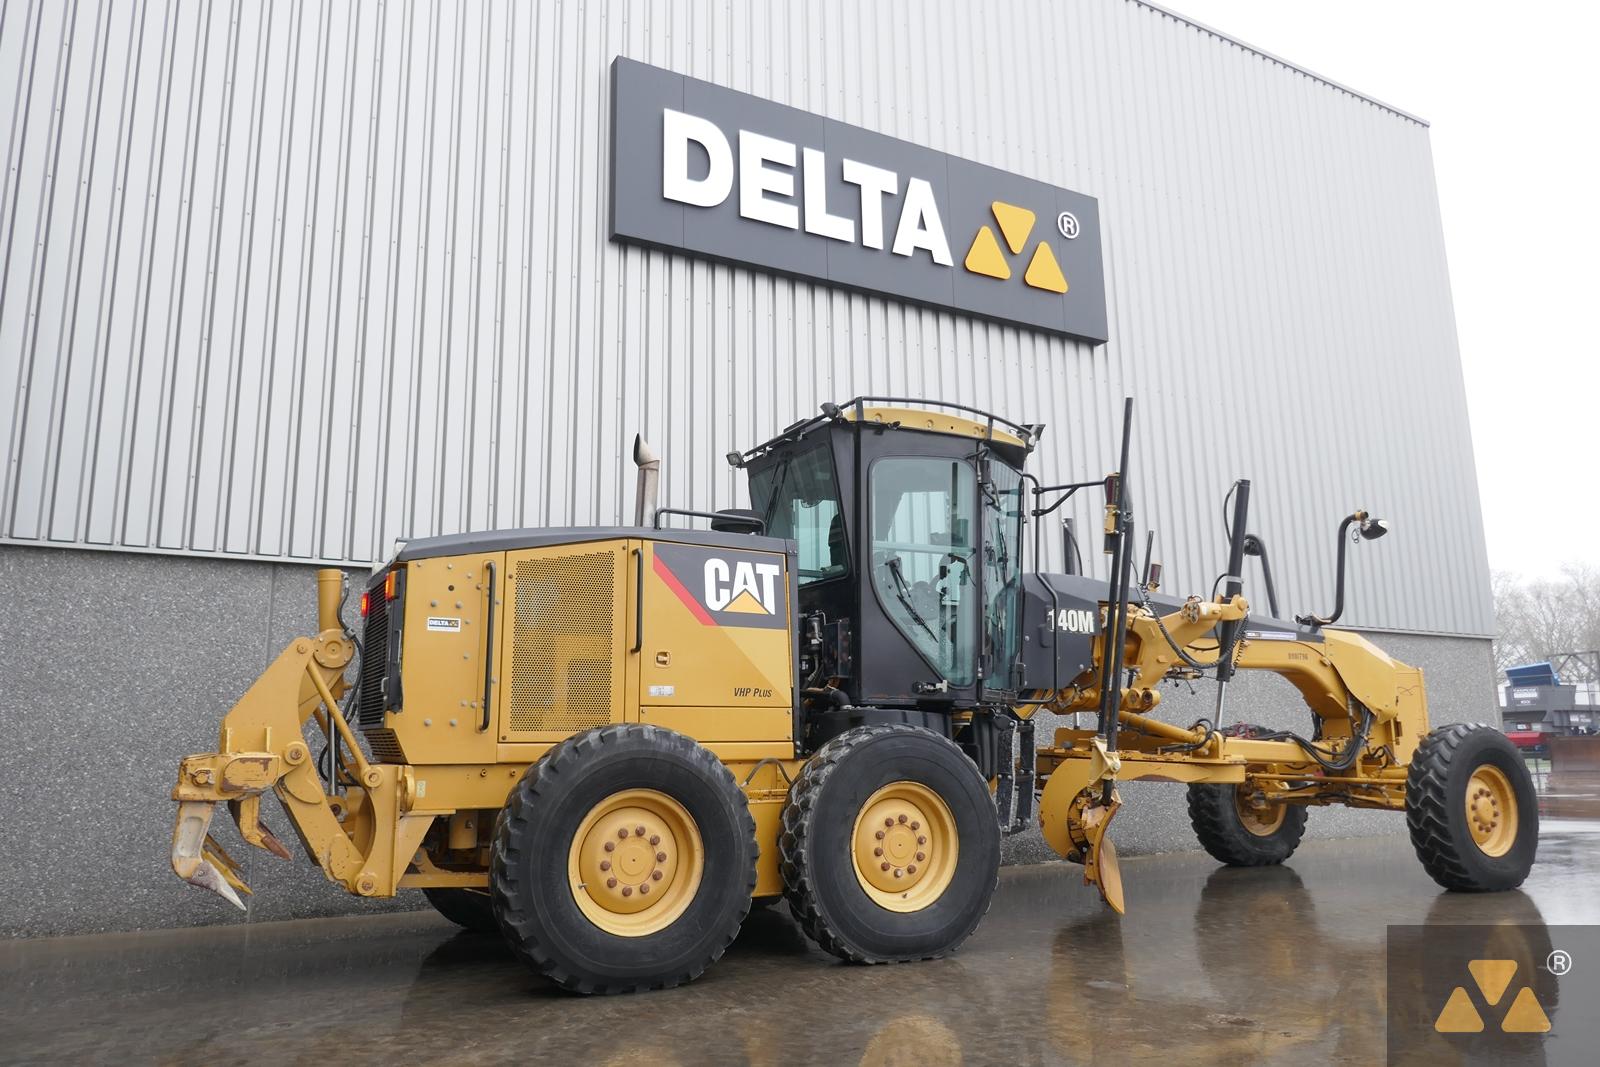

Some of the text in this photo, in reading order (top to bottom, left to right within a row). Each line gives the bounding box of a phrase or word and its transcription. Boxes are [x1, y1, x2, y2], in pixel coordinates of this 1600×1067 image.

[663, 108, 954, 267] DELTA
[704, 557, 780, 616] CAT
[1047, 609, 1095, 633] 140M
[734, 687, 752, 697] VHP
